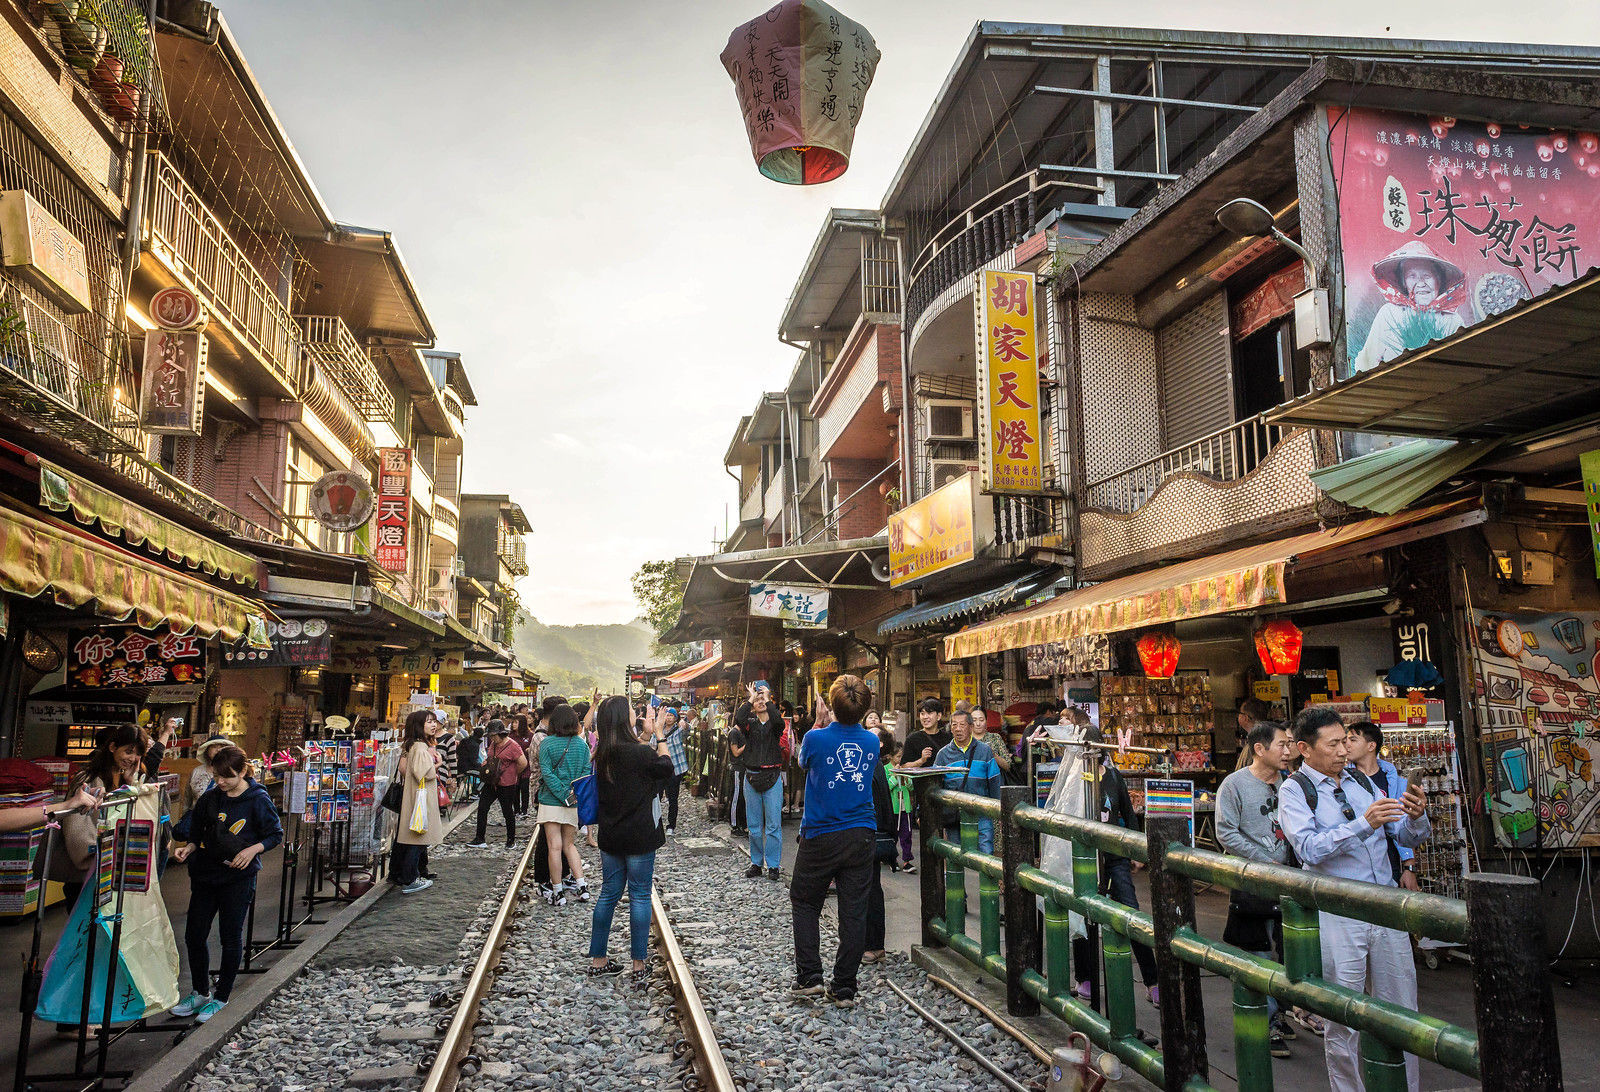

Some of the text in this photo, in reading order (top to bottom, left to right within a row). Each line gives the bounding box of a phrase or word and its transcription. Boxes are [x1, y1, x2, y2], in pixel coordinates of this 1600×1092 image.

[990, 274, 1036, 461] 胡家天燈
[378, 451, 407, 547] 協豐天燈
[74, 632, 201, 665] 你會紅
[107, 665, 168, 684] 天燈
[1411, 706, 1424, 718] 50
[835, 771, 864, 783] 天燈
